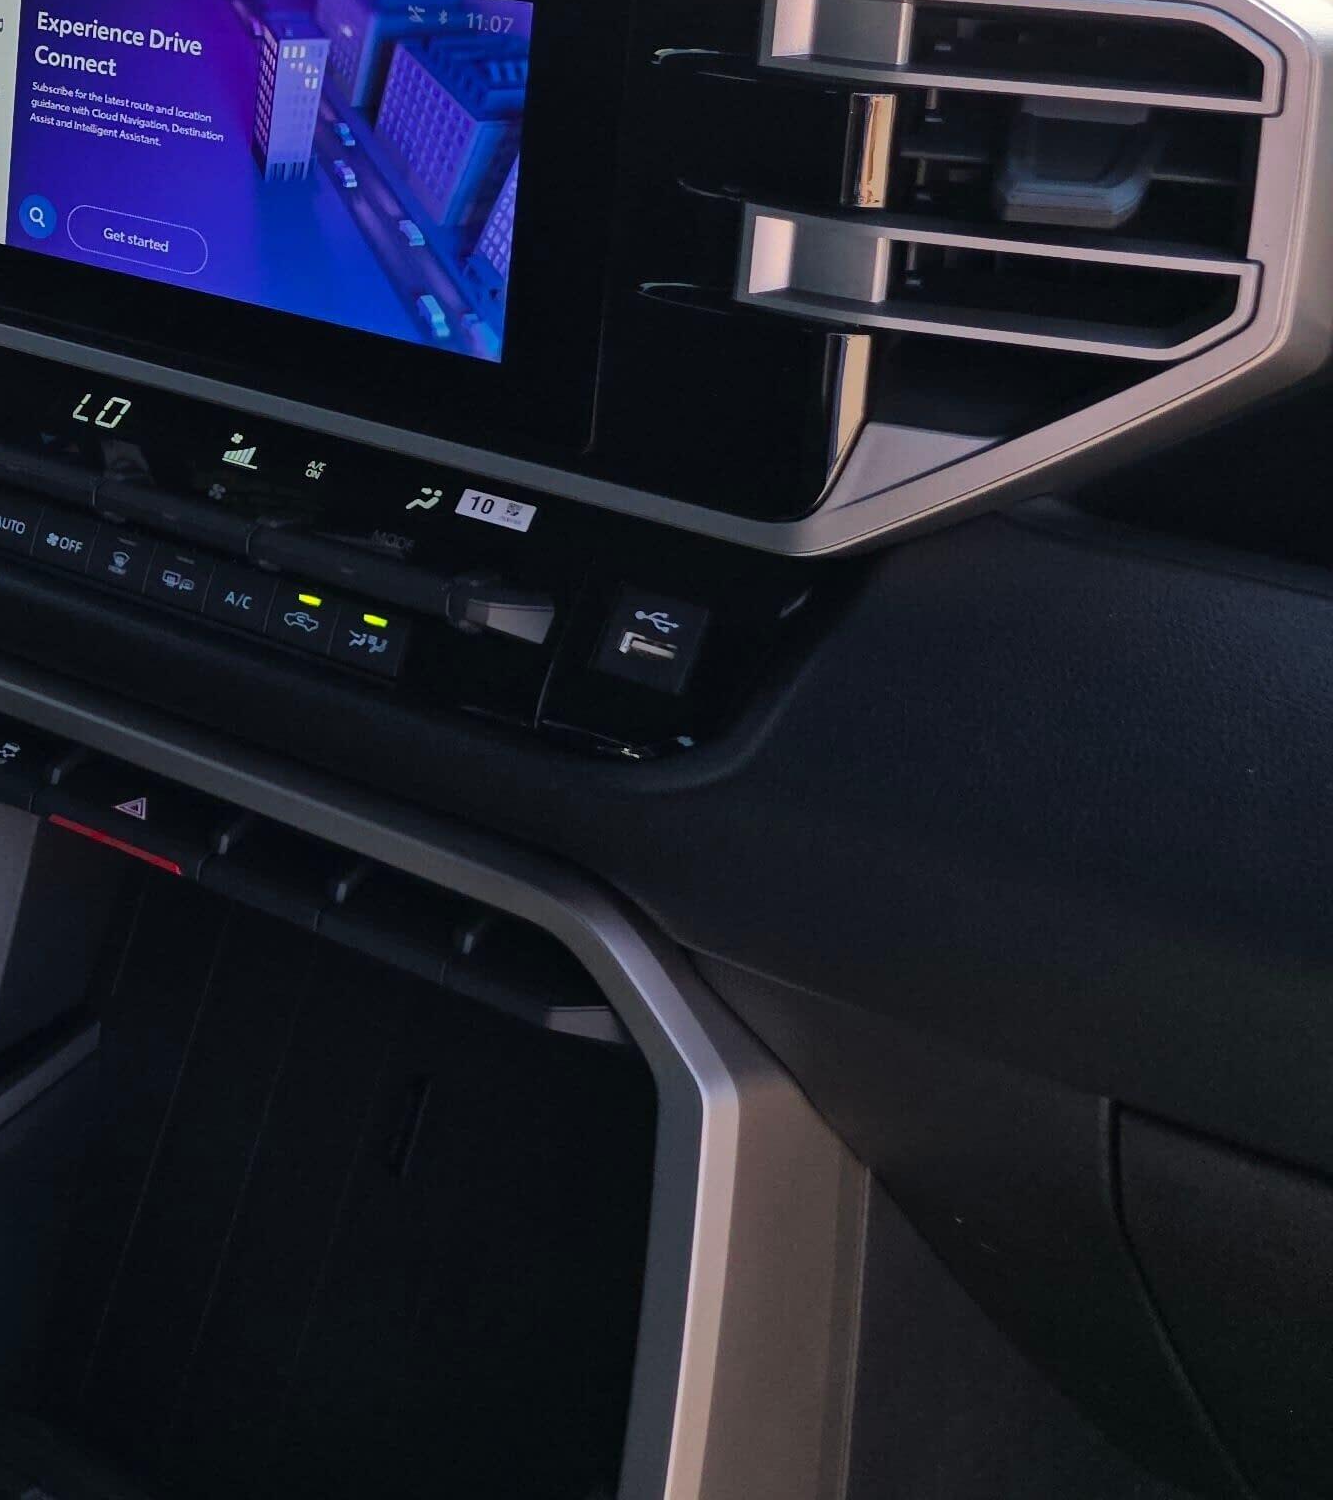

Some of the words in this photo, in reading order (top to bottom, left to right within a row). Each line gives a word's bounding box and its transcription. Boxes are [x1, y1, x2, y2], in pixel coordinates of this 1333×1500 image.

[37, 11, 145, 46] Experience
[149, 28, 202, 56] Drive
[466, 12, 514, 34] 11:07
[35, 45, 117, 77] Connect
[32, 81, 74, 98] Subscribe
[75, 89, 87, 100] for
[88, 91, 103, 103] the
[104, 94, 130, 108] latest
[130, 100, 155, 113] route
[155, 104, 174, 117] and
[175, 107, 212, 123] location
[30, 113, 55, 126] Assist
[56, 118, 73, 130] and
[74, 121, 118, 139] Intelligent
[119, 129, 162, 147] Assistant.
[31, 99, 71, 114] guidance
[72, 105, 90, 117] with
[92, 108, 119, 122] Cloud
[120, 113, 170, 133] Navigation,
[171, 124, 224, 142] Destination
[103, 227, 125, 243] Get
[127, 234, 169, 253] started
[305, 468, 321, 480] ON
[471, 496, 495, 514] 10
[59, 536, 83, 553] OFF
[224, 591, 252, 610] A/C
